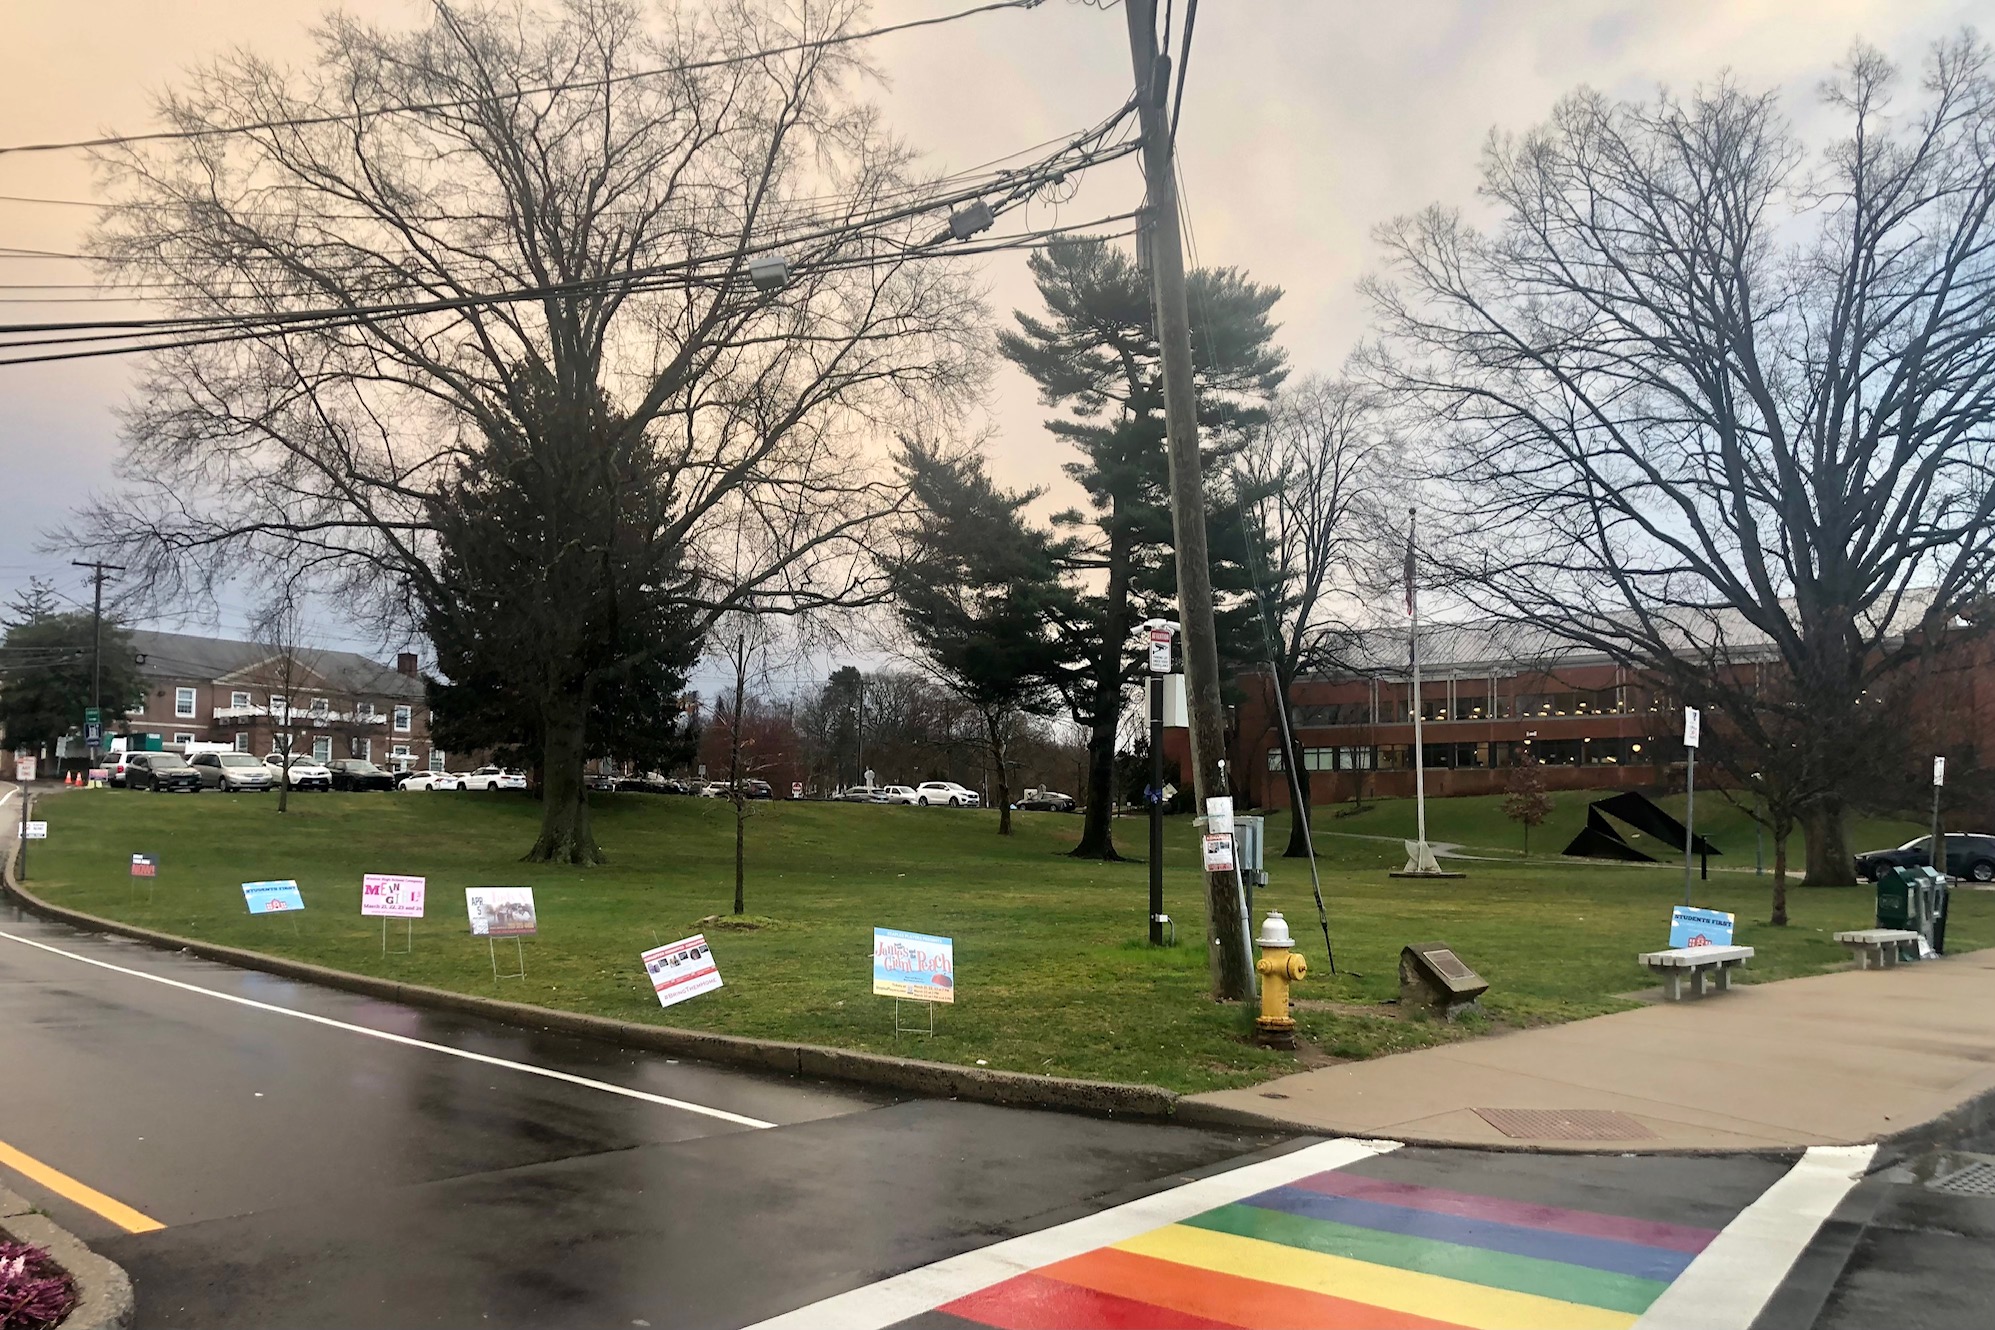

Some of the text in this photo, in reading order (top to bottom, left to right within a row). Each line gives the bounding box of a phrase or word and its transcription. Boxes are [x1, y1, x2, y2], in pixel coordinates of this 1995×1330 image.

[1674, 914, 1732, 927] STUDENTS FIRST
[875, 941, 909, 958] James
[884, 950, 952, 973] Giant Peach
